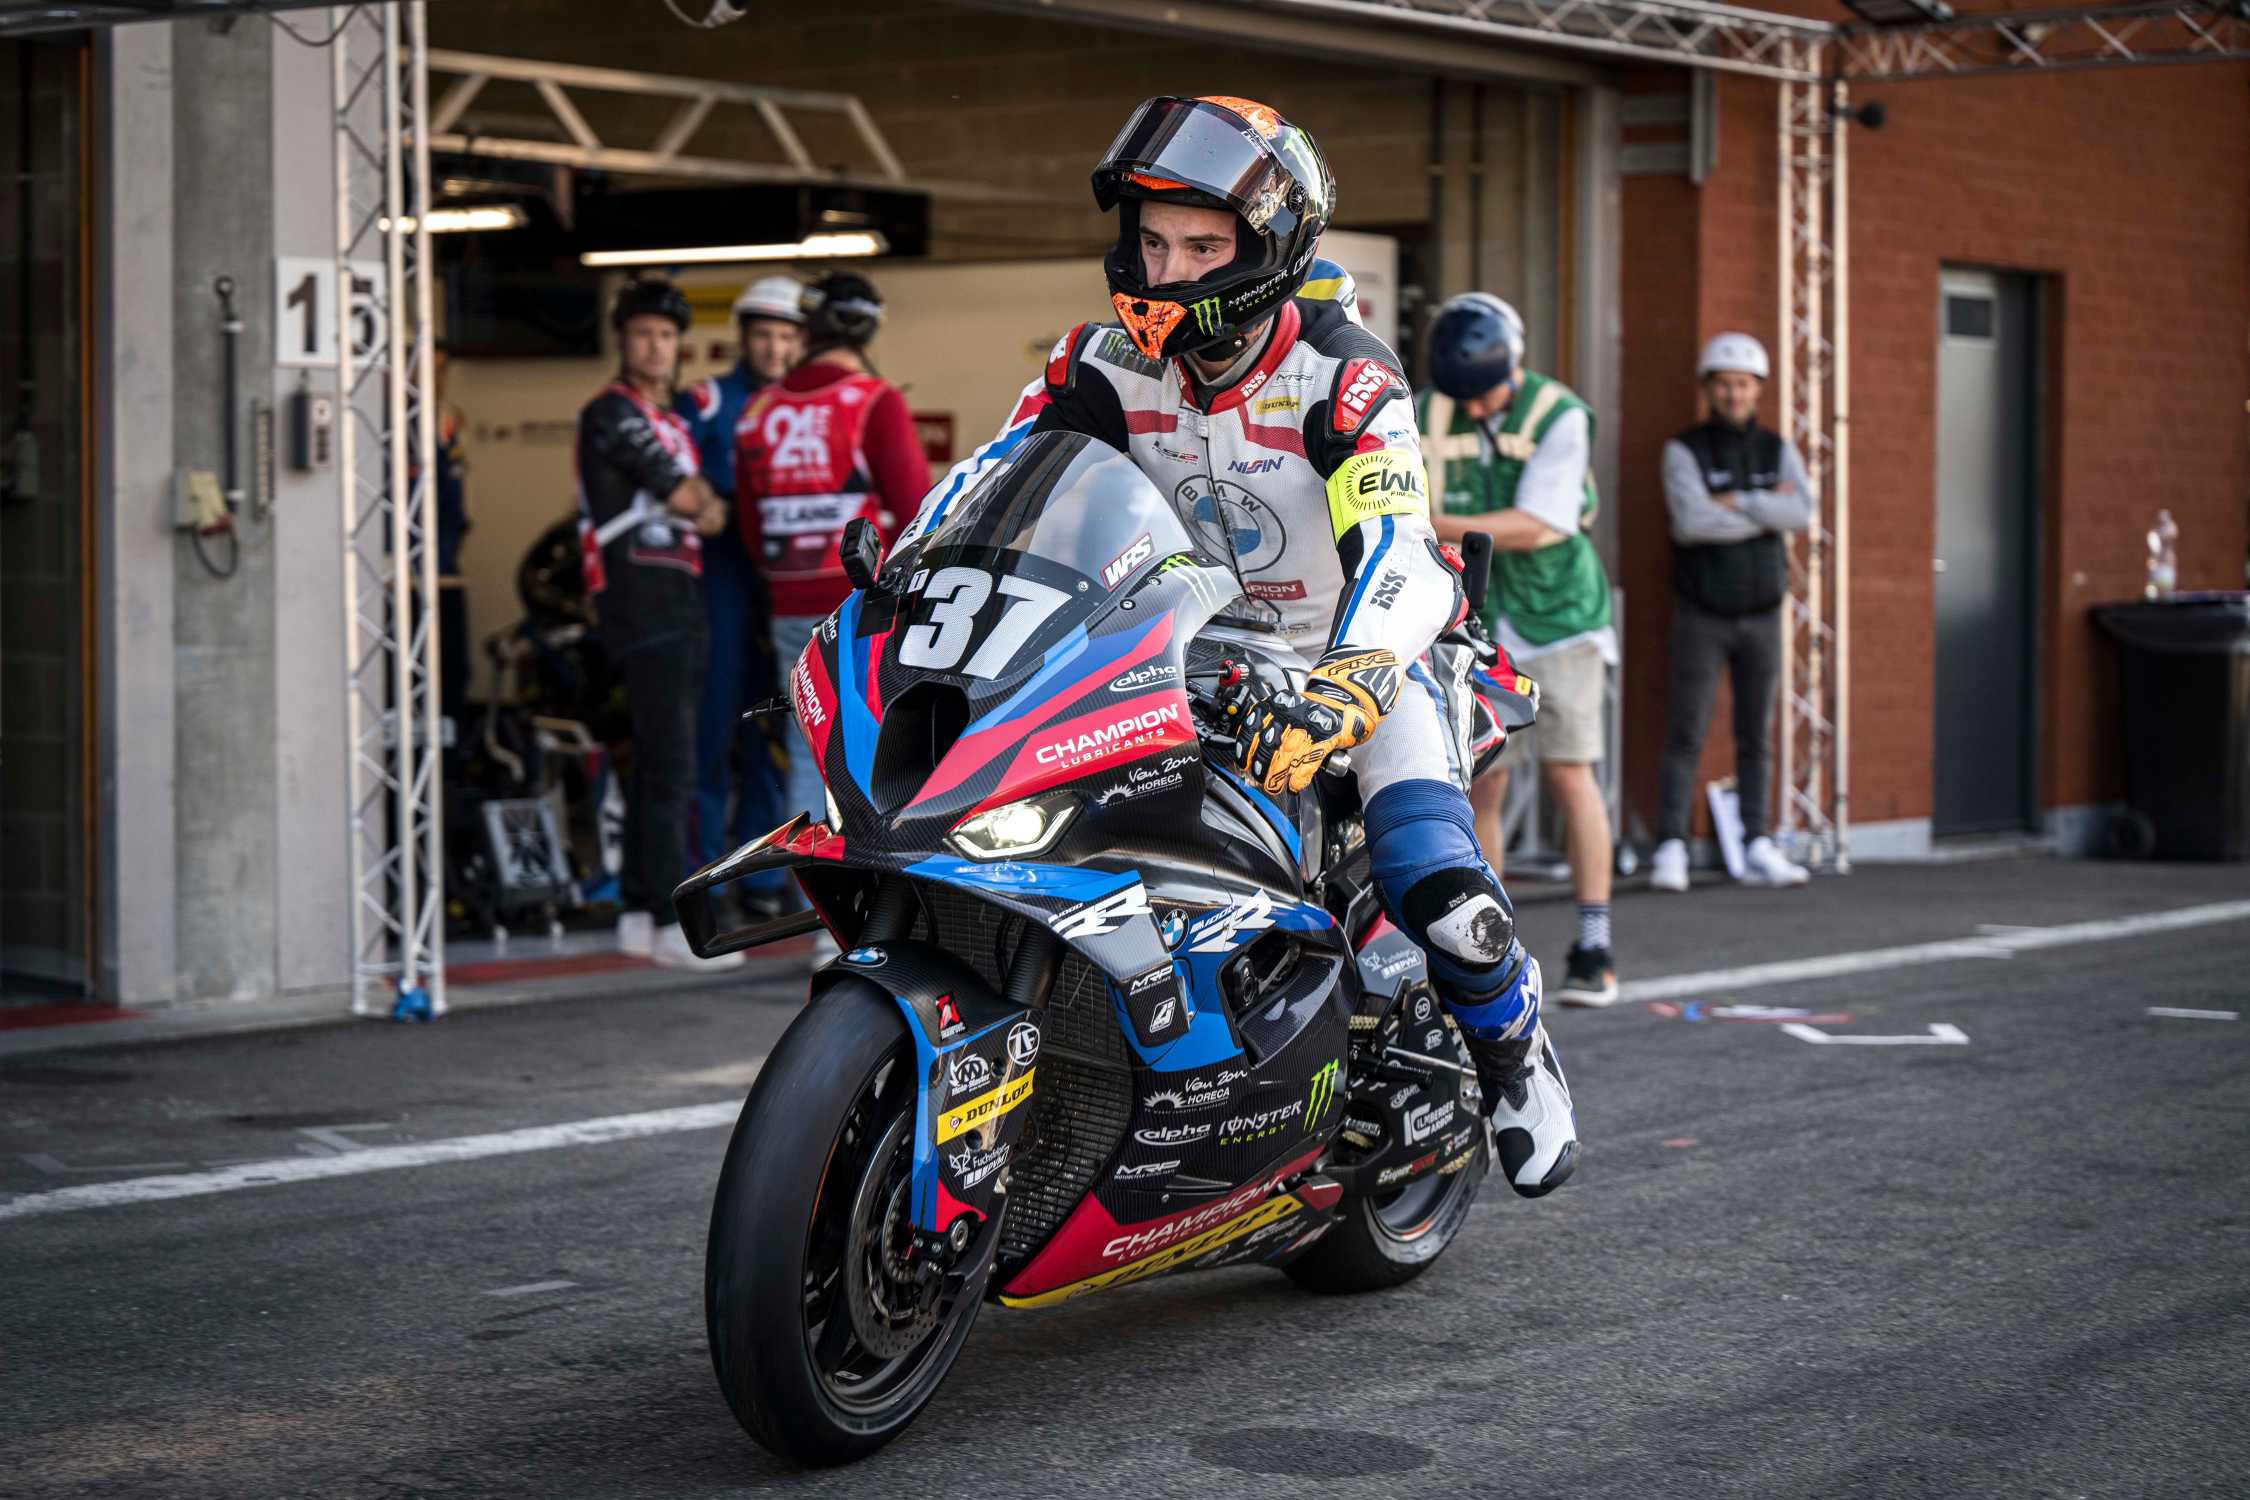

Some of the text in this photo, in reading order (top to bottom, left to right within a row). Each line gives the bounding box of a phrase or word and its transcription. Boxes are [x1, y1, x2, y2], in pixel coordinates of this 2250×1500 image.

[1104, 536, 1151, 587] WRS
[898, 566, 1072, 681] 37
[1116, 665, 1177, 687] alpha
[1328, 650, 1396, 677] FIVE
[1035, 705, 1178, 764] CHAMPION
[1061, 728, 1165, 768] LUBRICANTS
[1137, 773, 1183, 792] HORECA
[1008, 1024, 1039, 1064] ZF
[966, 1081, 1030, 1122] DUNLOP
[1187, 1088, 1230, 1104] HORECA
[1145, 1123, 1211, 1142] alpha
[1103, 1174, 1282, 1258] CHAMPION
